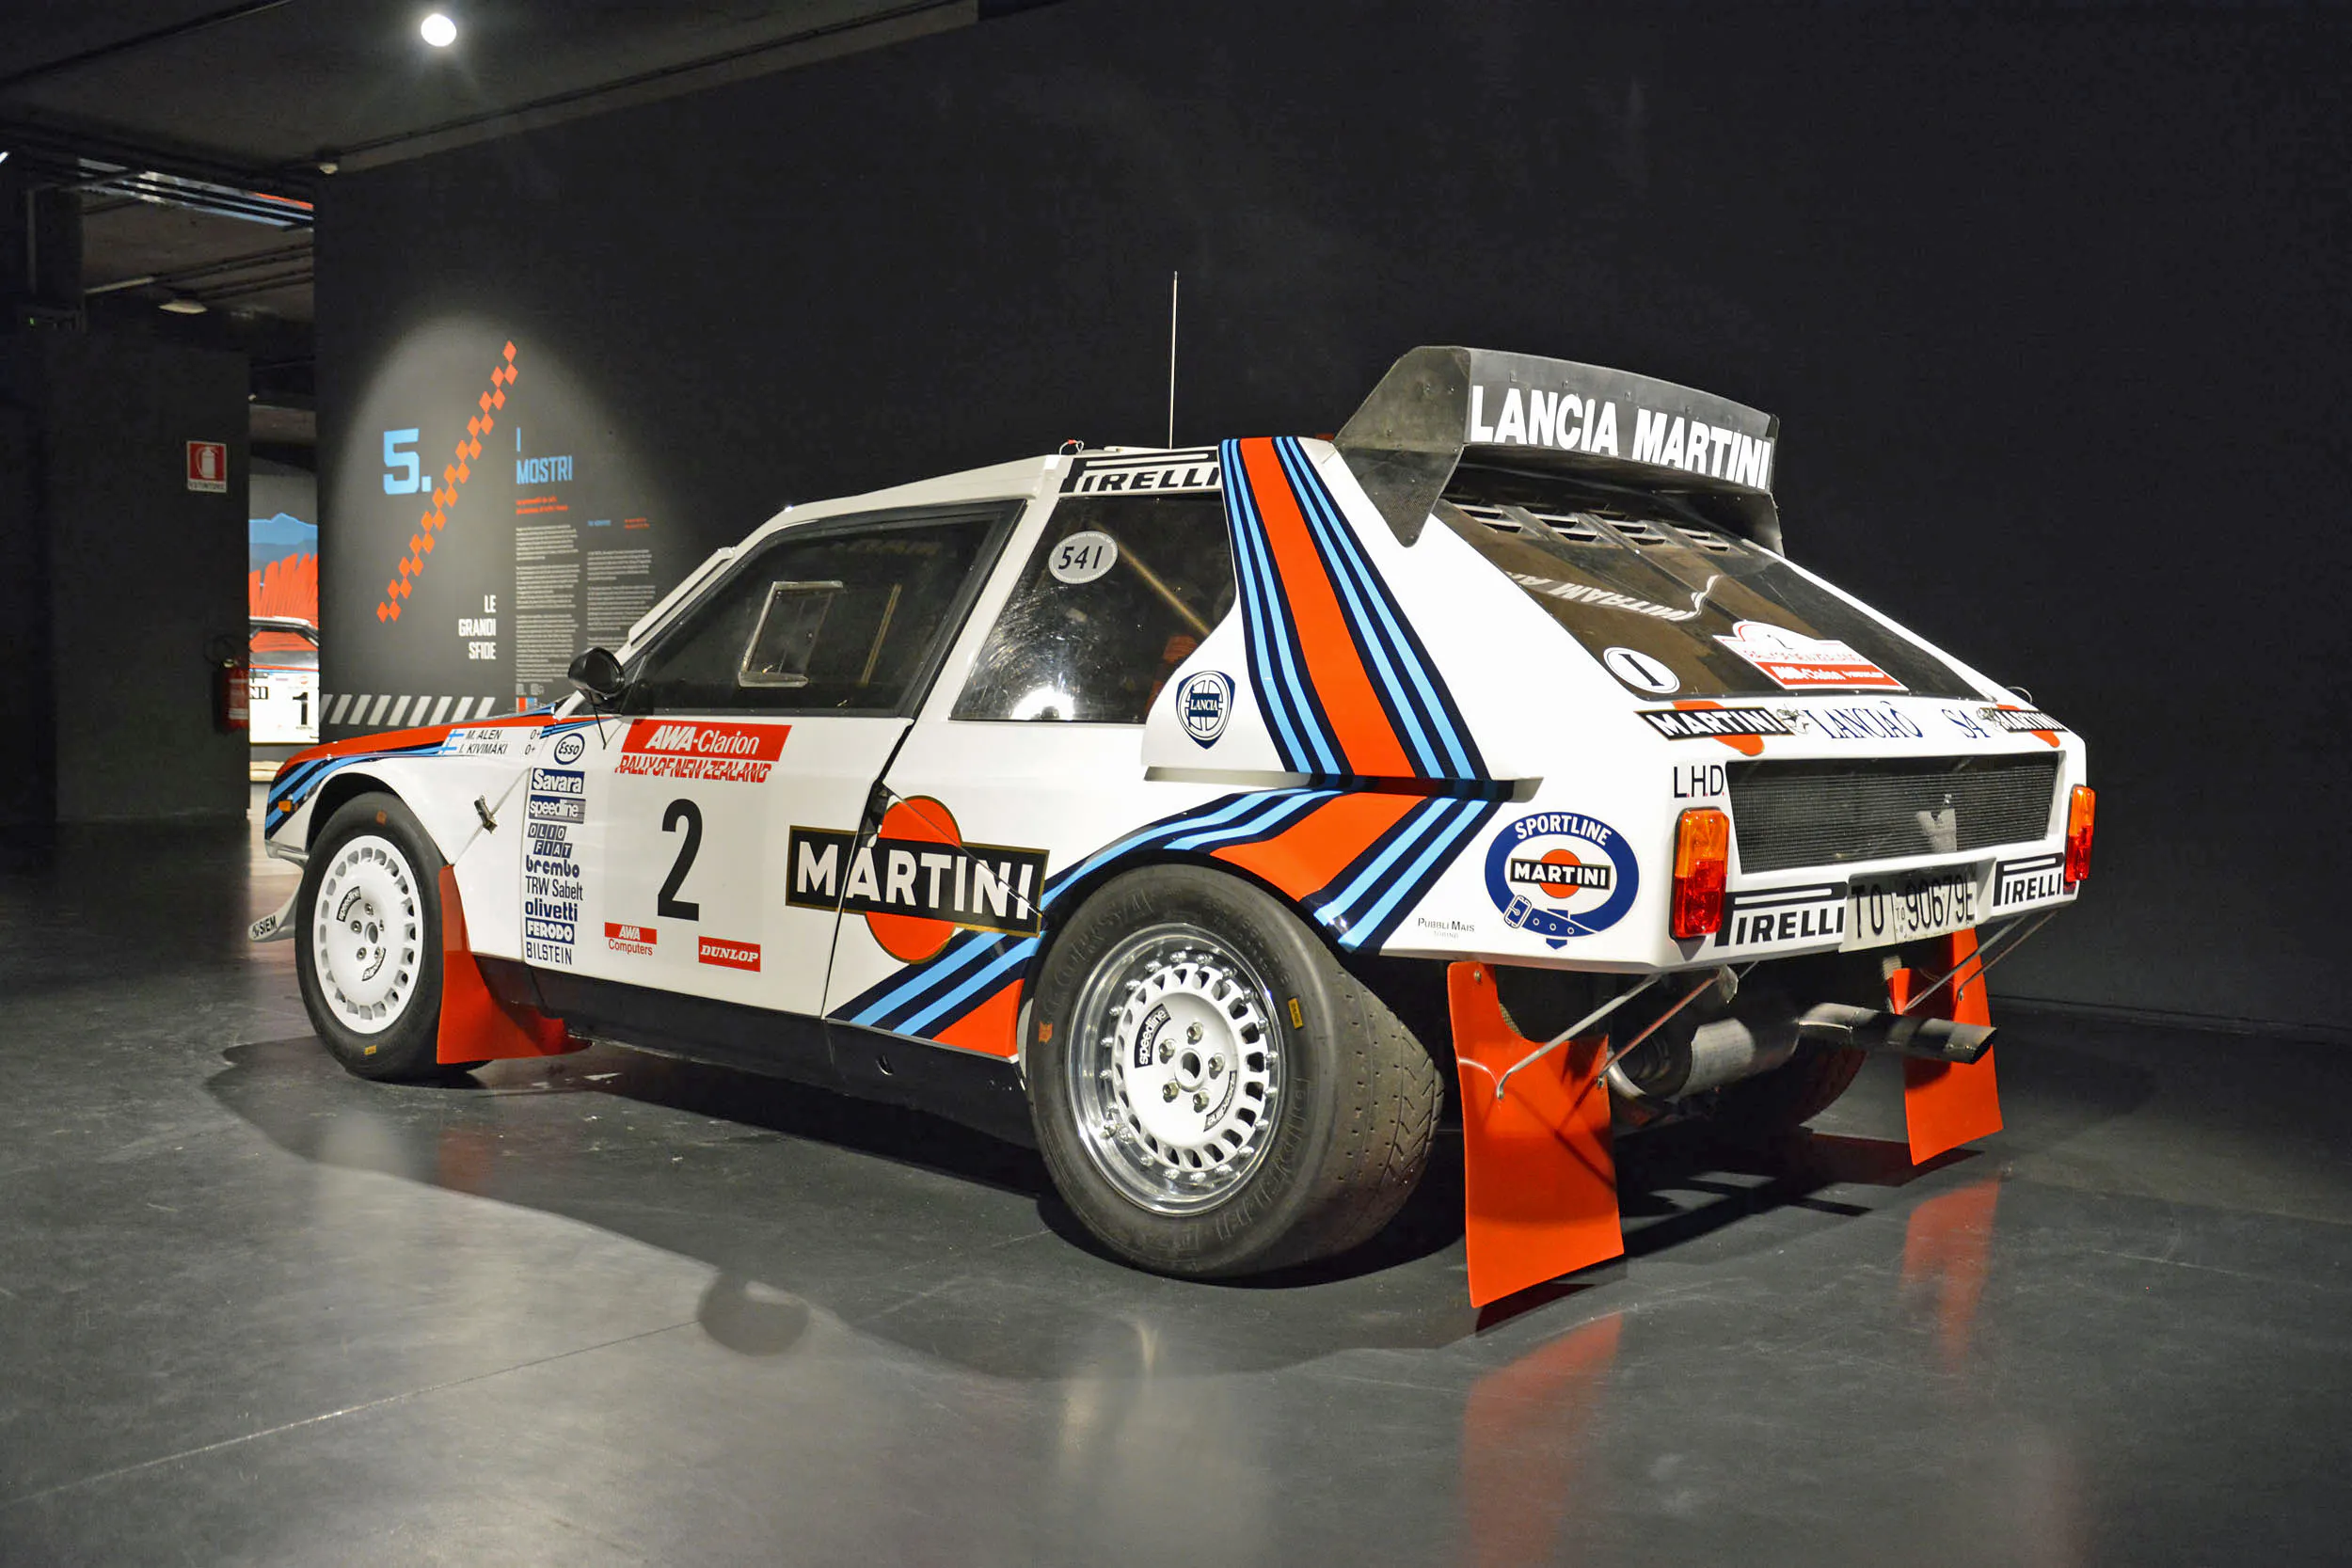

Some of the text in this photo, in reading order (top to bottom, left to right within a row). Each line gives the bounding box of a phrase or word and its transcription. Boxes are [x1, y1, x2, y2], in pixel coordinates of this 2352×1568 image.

[1470, 385, 1772, 490] LANCIA MARTINI
[383, 428, 432, 495] 5.
[516, 455, 573, 484] MOSTRI
[1058, 450, 1220, 493] PIRELLI
[1057, 546, 1104, 570] 541
[484, 594, 497, 613] LE
[458, 618, 497, 637] GRANDI
[469, 641, 497, 659] SFIDE
[1191, 699, 1218, 711] LANCIA
[476, 729, 503, 740] ALEN
[1645, 710, 1787, 736] MARTINI
[644, 724, 760, 755] AWA-Clarion
[532, 768, 583, 793] Savara
[614, 754, 773, 784] RALLY OF NEW ZEALAND
[530, 799, 579, 817] speedline
[529, 825, 565, 839] OLIO
[1514, 814, 1613, 847] SPORTLINE
[534, 842, 572, 857] FIAT
[657, 798, 703, 922] 2
[525, 854, 580, 879] brembo
[1513, 862, 1607, 887] MARTINI
[1993, 851, 2064, 907] PIRELLI
[525, 875, 583, 901] TRW Sabelt
[796, 840, 1034, 921] MARTINI
[524, 897, 578, 922] olivetti
[1714, 880, 1848, 947] PIRELLI
[1851, 883, 1884, 939] TO
[1904, 874, 1976, 931] 90679E
[527, 920, 574, 942] FERODO
[619, 925, 641, 941] AWA
[526, 941, 573, 966] BILSTEIN
[608, 939, 653, 957] Computers
[700, 944, 759, 963] DUNLOP
[1139, 1009, 1167, 1065] speedline
